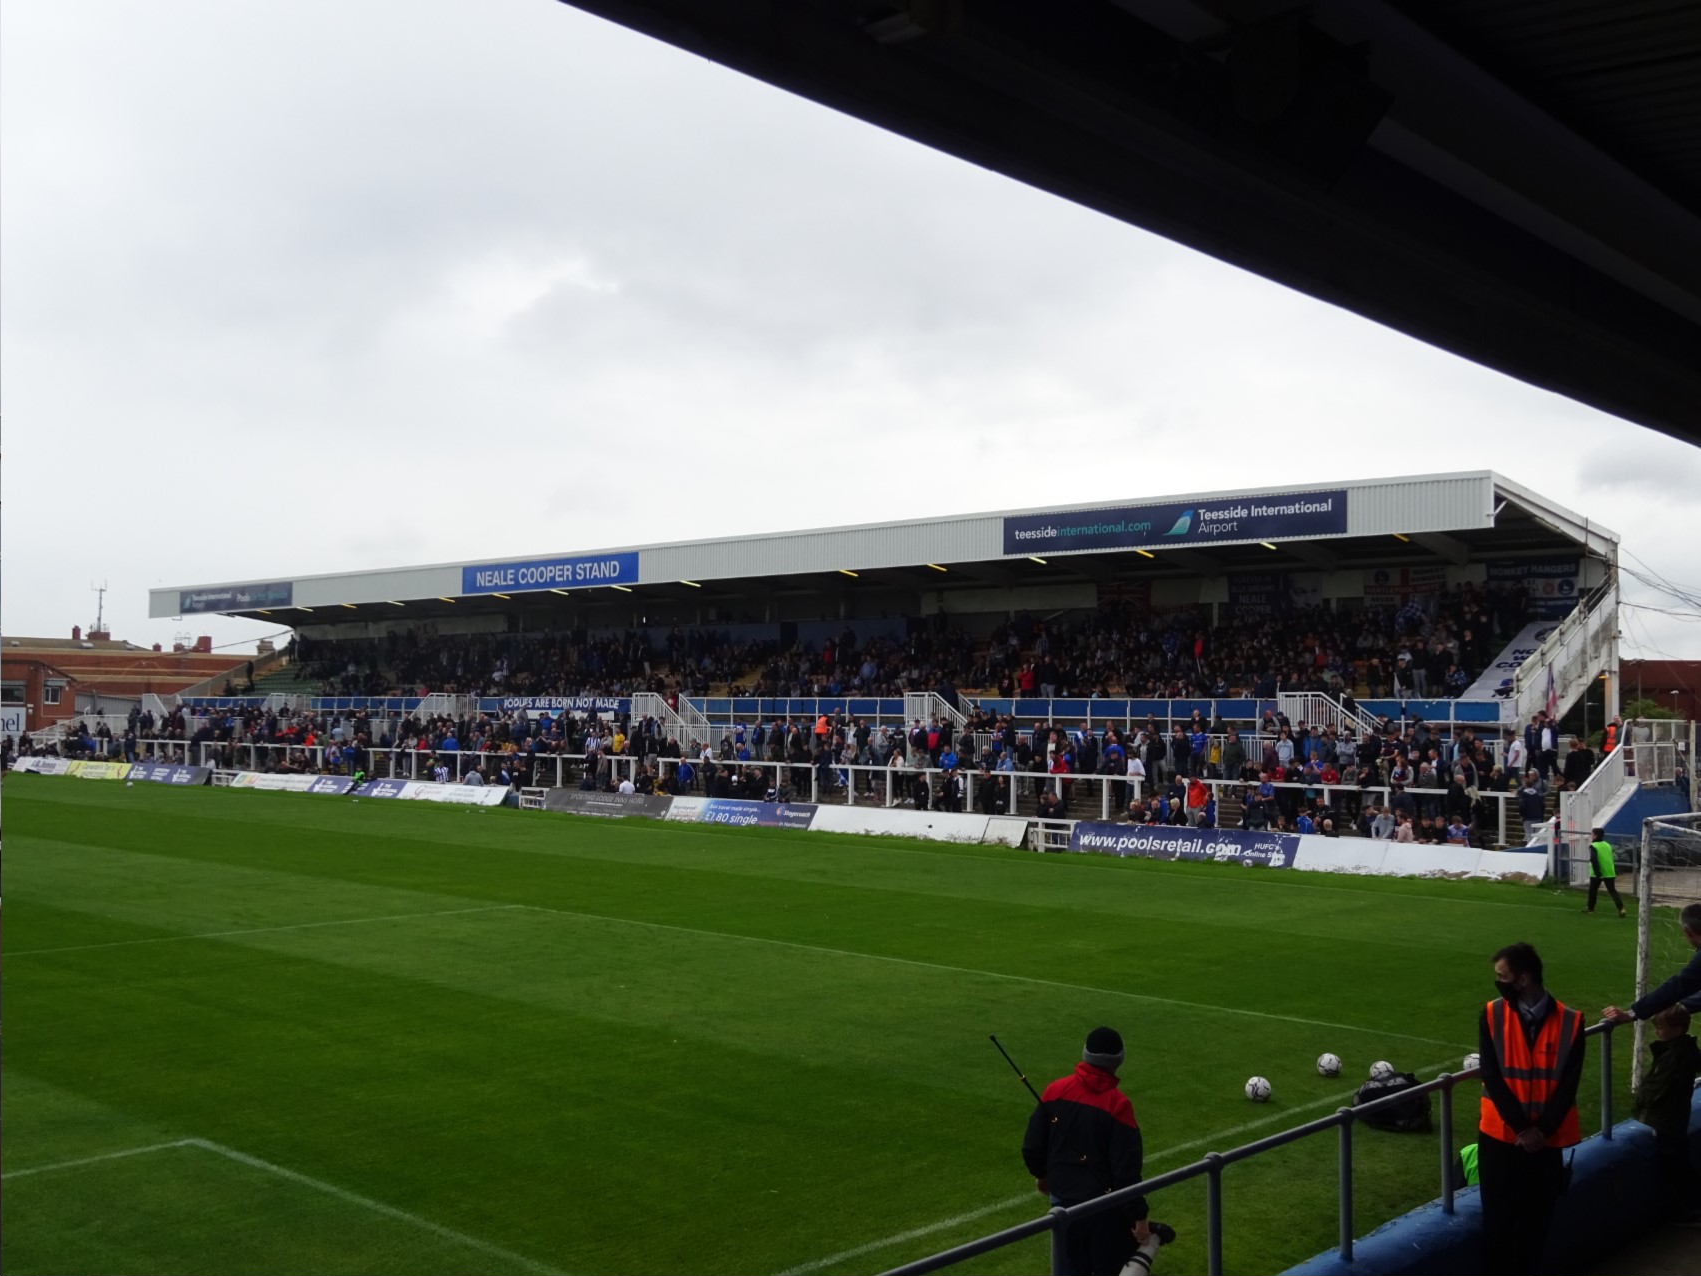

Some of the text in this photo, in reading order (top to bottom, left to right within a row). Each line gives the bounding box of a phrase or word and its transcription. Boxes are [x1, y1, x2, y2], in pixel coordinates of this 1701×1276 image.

[1199, 499, 1332, 522] Teesside International
[1015, 520, 1151, 539] teessideinternational.com
[1198, 520, 1238, 535] Airport
[476, 561, 620, 587] NEALE COOPER STAND
[535, 698, 550, 708] ARE
[552, 698, 574, 708] BORN
[576, 698, 593, 708] NOT
[595, 699, 620, 709] MADE
[705, 811, 729, 823] £1.80
[729, 814, 758, 826] single
[783, 810, 811, 818] Stagecoach
[1079, 835, 1242, 856] www.poolsretail.com
